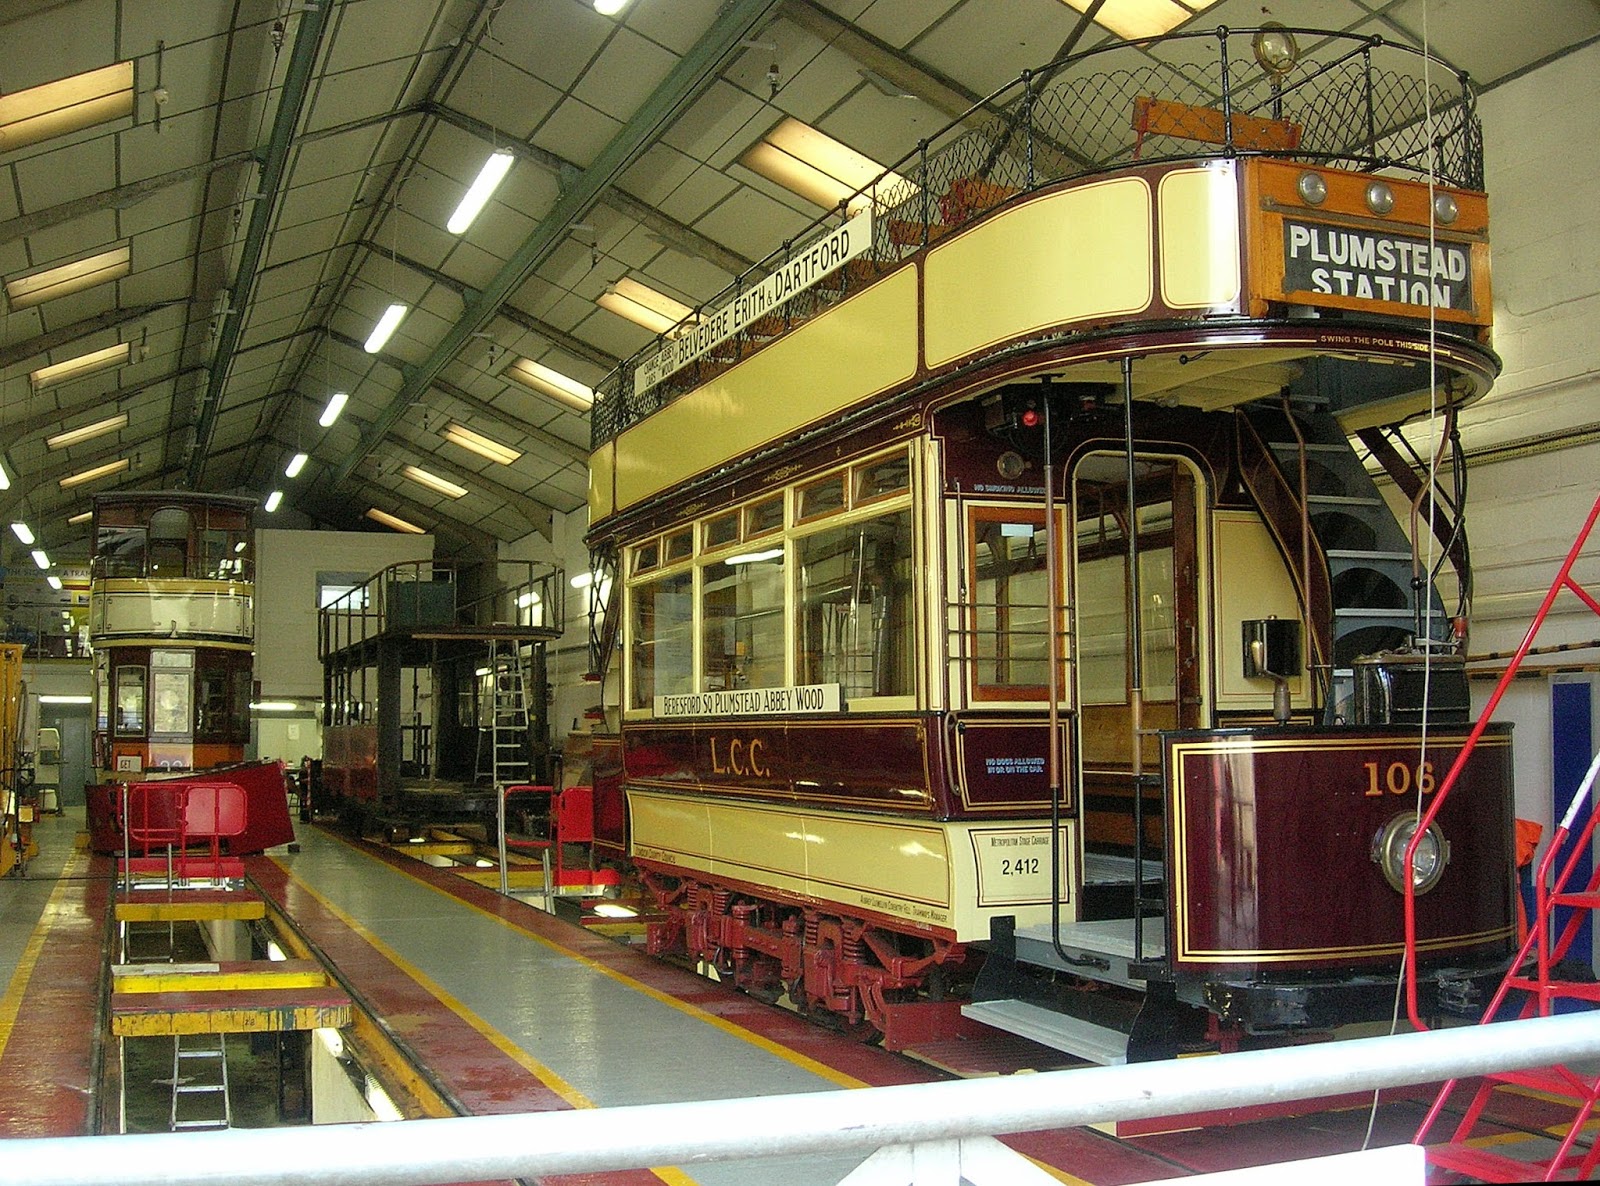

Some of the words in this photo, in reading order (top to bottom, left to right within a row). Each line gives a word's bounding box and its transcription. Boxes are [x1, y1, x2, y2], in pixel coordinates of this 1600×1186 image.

[1290, 225, 1466, 282] PLUMSTEAD
[678, 311, 728, 364] BELVEDERE
[734, 291, 765, 327] ERITH
[766, 293, 774, 306] &
[775, 229, 850, 301] DARTFORD
[1311, 268, 1450, 309] STATION
[1320, 335, 1351, 343] SWING
[1353, 336, 1370, 345] THE
[1373, 337, 1394, 347] POLE
[1395, 340, 1412, 350] THIS
[1413, 342, 1429, 352] SIDE
[663, 696, 701, 715] BERESFORD
[703, 693, 713, 714] SQ
[715, 692, 761, 714] PLUMSTEAD
[764, 689, 793, 712] ABBEY
[795, 687, 824, 710] WOOD
[985, 758, 995, 766] NO
[996, 758, 1013, 766] DOGS
[996, 766, 1005, 774] OR
[1017, 765, 1028, 773] THE
[1364, 762, 1435, 796] 106
[1002, 858, 1039, 876] 2,412
